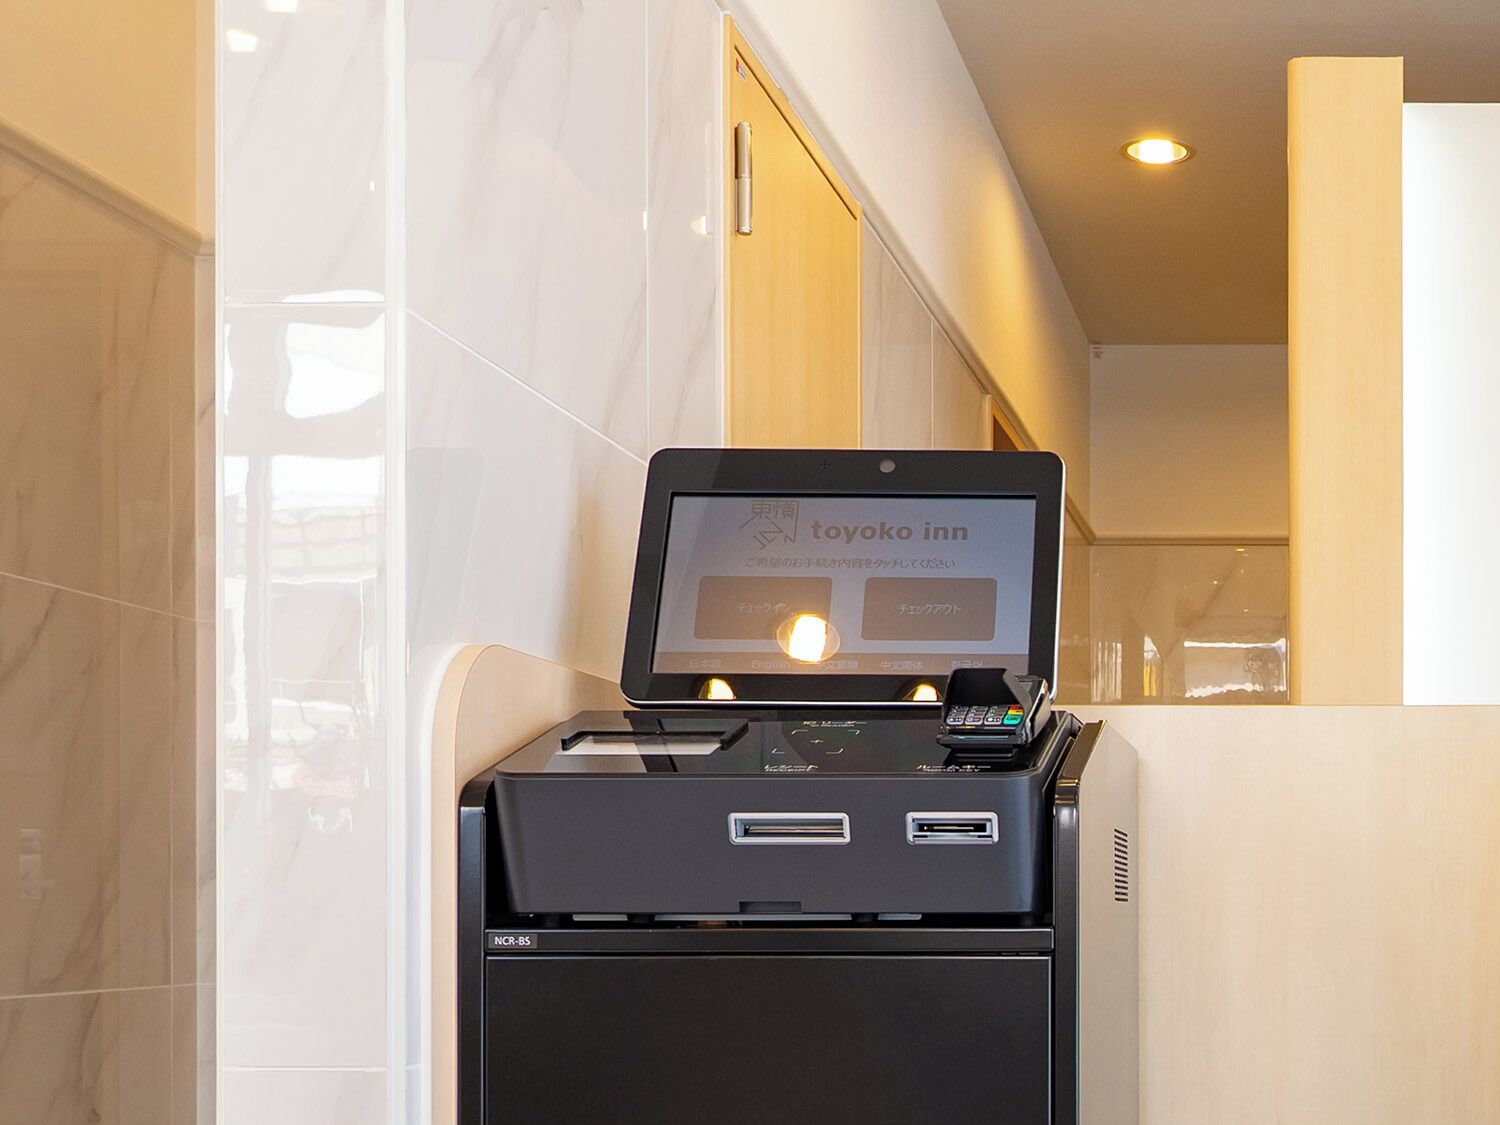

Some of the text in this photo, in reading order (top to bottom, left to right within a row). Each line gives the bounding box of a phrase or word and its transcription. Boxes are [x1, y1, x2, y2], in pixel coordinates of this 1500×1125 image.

[811, 520, 969, 544] toyoko inn
[898, 603, 963, 616] チェックアウト
[493, 935, 532, 946] NCR-BS
